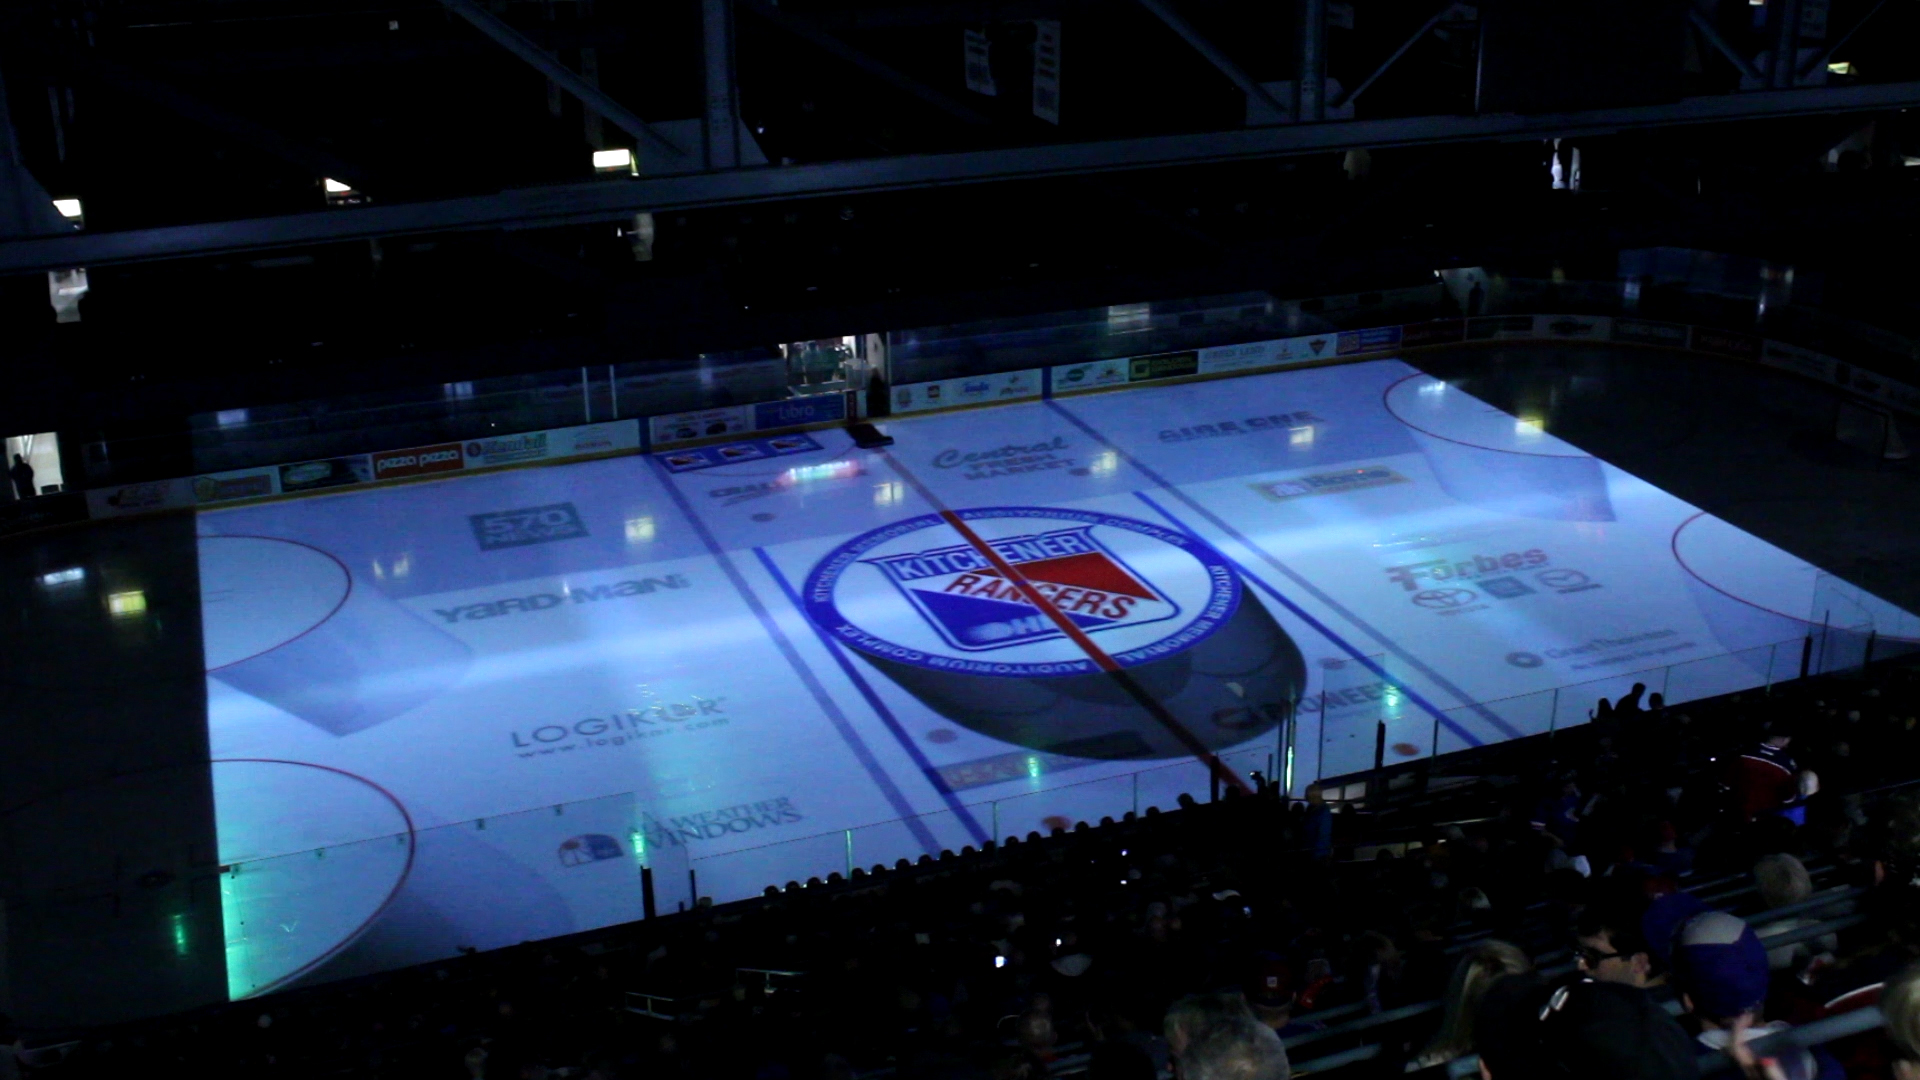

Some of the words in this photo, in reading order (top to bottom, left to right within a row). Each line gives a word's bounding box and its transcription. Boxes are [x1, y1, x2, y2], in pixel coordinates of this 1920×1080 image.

[377, 455, 418, 473] pizza
[419, 449, 460, 467] pizza
[483, 510, 571, 533] 570
[893, 533, 1090, 581] KITCHENER
[1386, 548, 1548, 592] Forbes
[944, 572, 1136, 619] RANGERS
